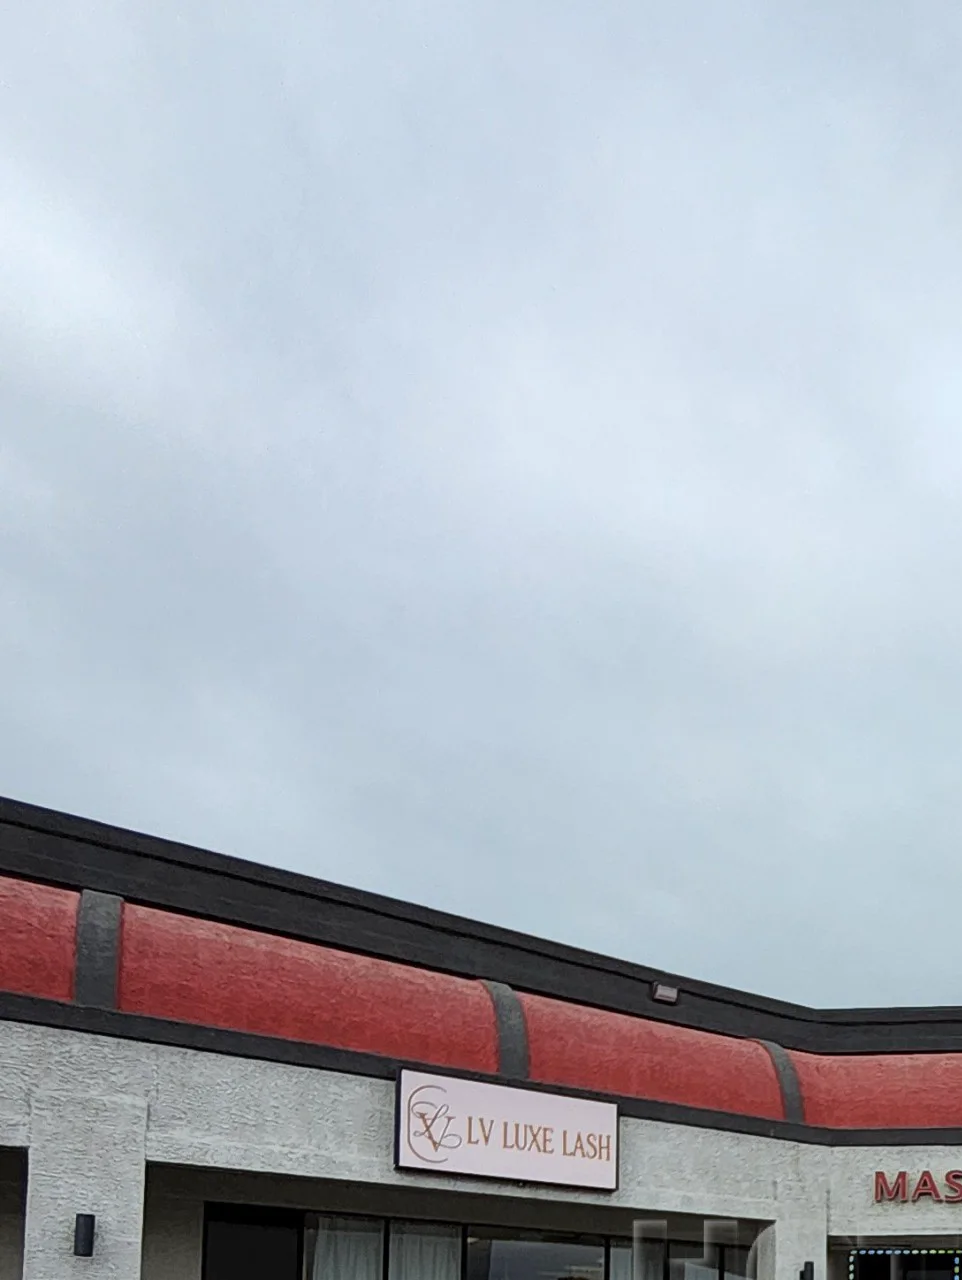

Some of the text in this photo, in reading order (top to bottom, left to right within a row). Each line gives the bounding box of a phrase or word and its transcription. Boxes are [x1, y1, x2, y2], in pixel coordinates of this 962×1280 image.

[467, 1115, 611, 1162] LV LUXE LASH
